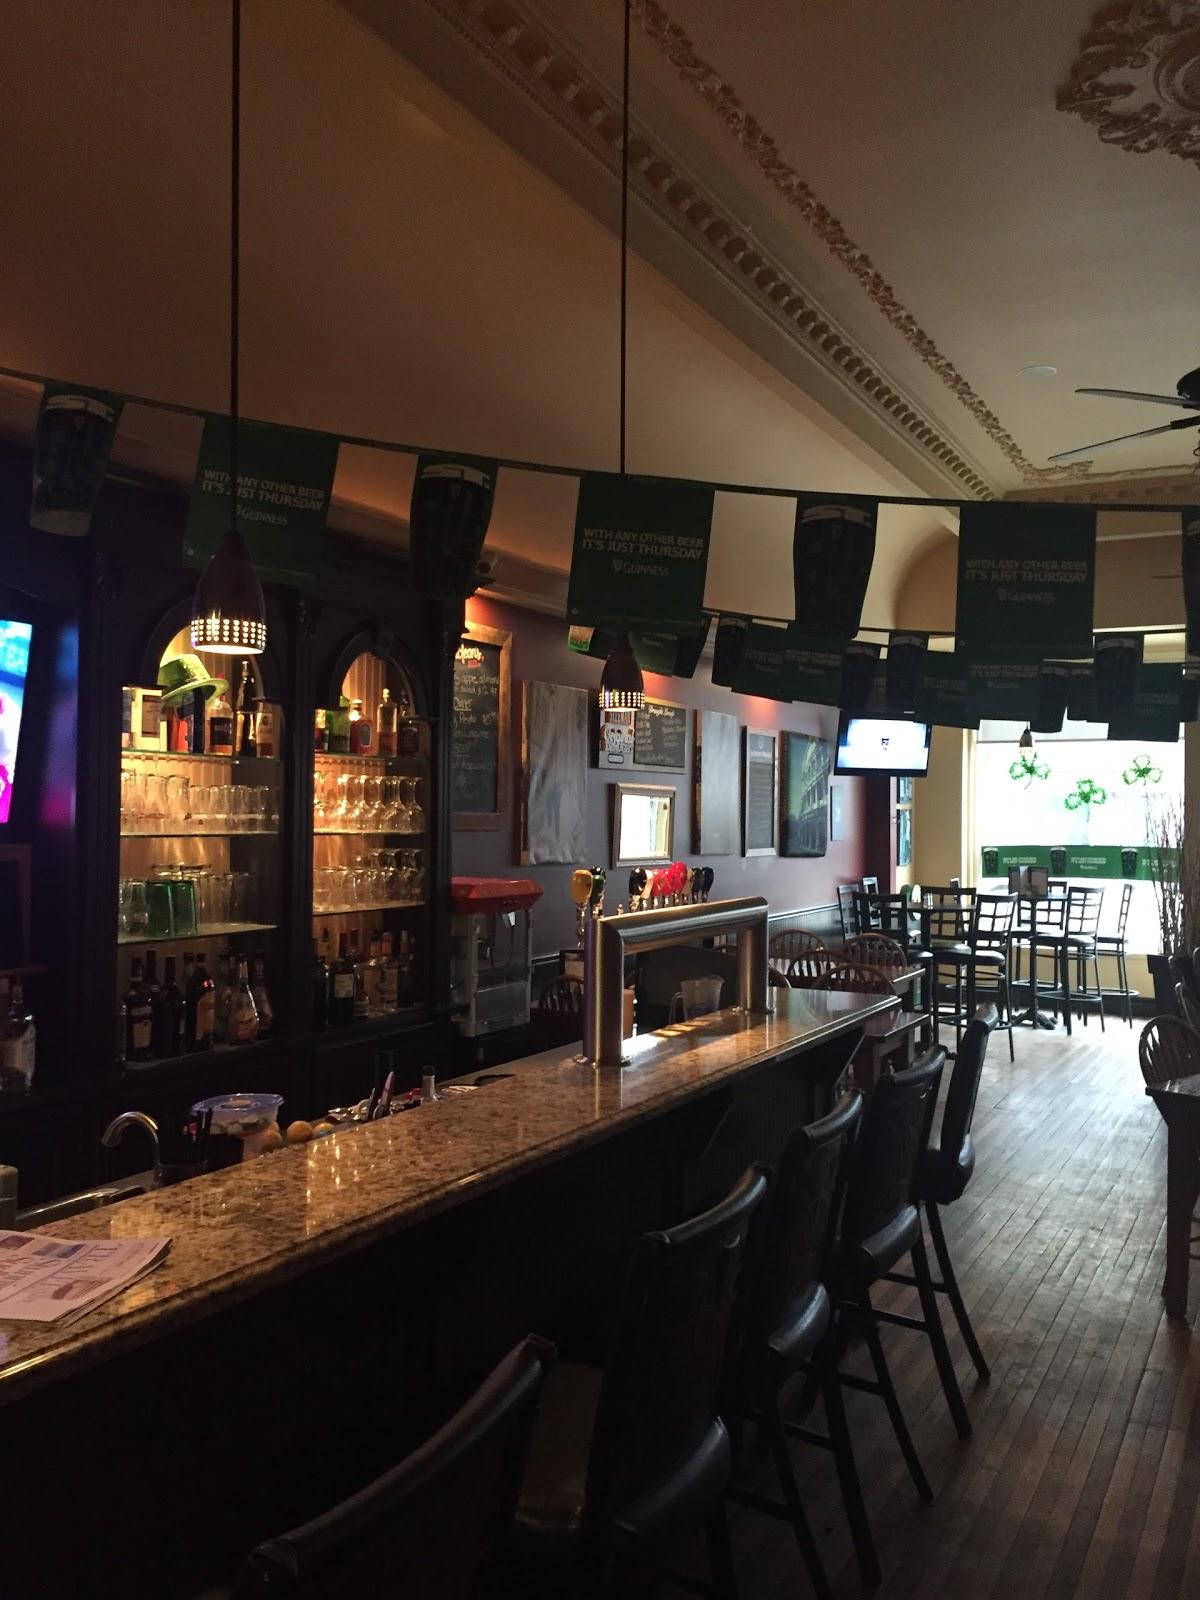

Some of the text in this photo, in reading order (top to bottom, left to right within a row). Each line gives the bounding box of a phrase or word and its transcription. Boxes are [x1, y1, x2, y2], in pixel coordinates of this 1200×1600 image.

[202, 480, 225, 494] IT'S
[258, 490, 324, 511] THURSDAY
[236, 475, 260, 488] ANY
[260, 480, 296, 494] OTHER
[298, 486, 325, 499] BEER
[583, 528, 704, 548] WITH ANY OTHER BEER
[583, 539, 704, 560] IT'S JUST THURSDAY
[965, 560, 1088, 570] WITH ANY OTHER BEER
[965, 570, 1088, 582] IT'S JUST THURSDAY
